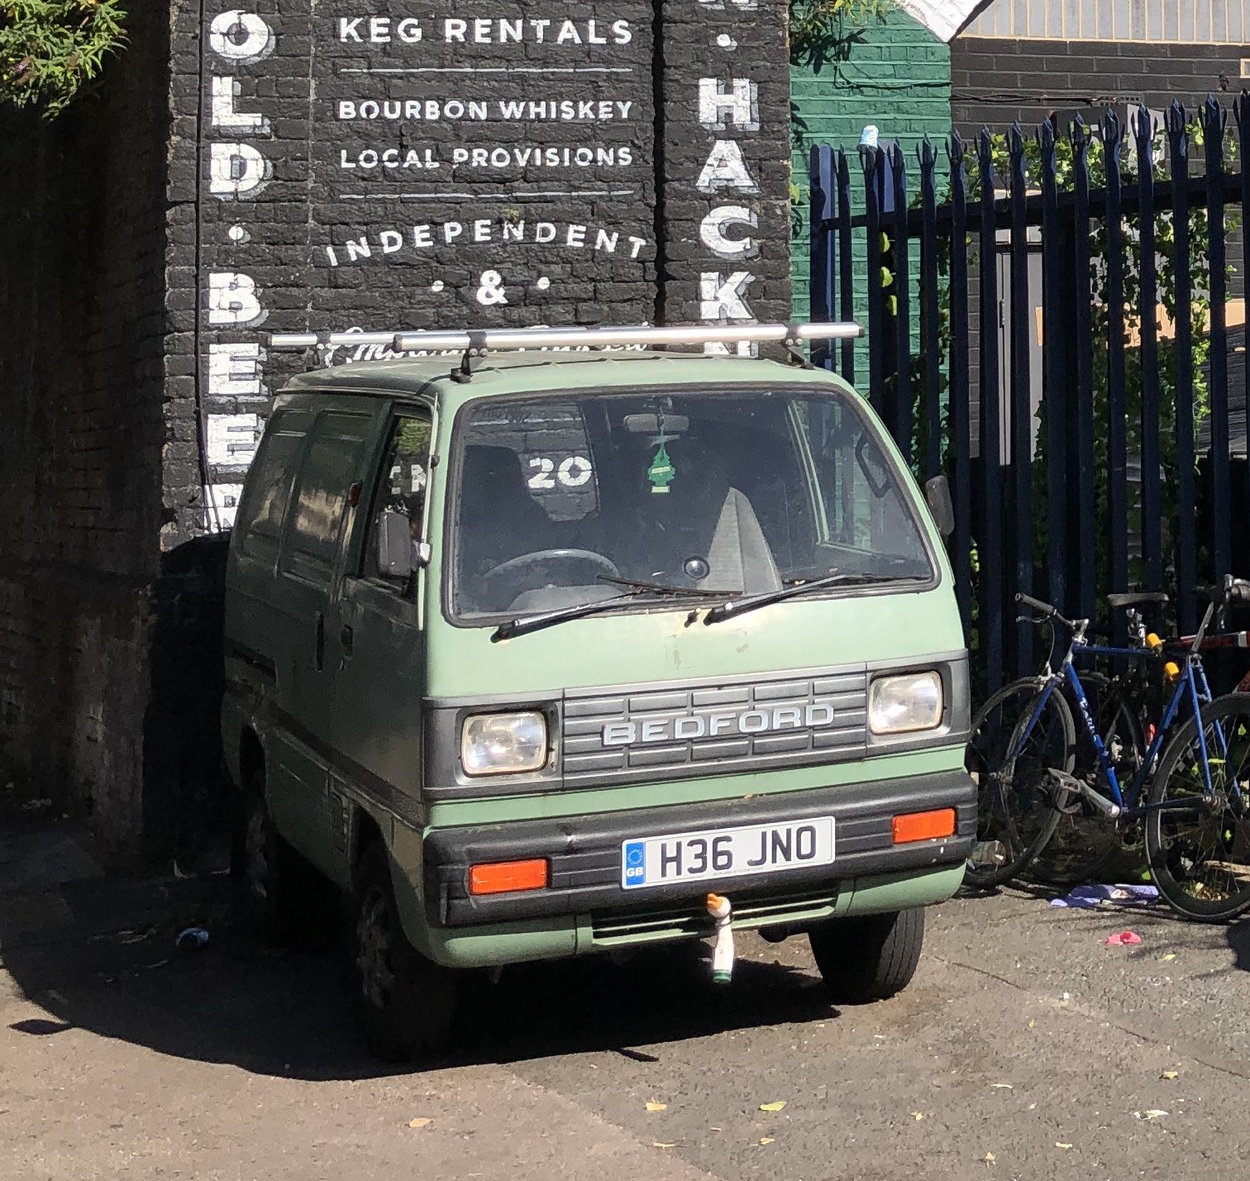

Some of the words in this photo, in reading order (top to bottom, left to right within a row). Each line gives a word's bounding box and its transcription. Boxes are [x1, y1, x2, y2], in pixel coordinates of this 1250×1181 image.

[339, 18, 422, 42] KEG
[445, 18, 632, 46] RENTALS
[339, 100, 487, 120] BOURBON
[499, 100, 633, 120] WHISKEY
[340, 149, 439, 169] LOCAL
[452, 147, 633, 168] PROVISIONS
[696, 78, 760, 357] HACK
[326, 219, 648, 267] INDEPENDENT
[603, 703, 835, 746] BEDFORD
[660, 835, 734, 878] H36
[746, 825, 817, 867] JNO
[626, 867, 644, 878] GB
